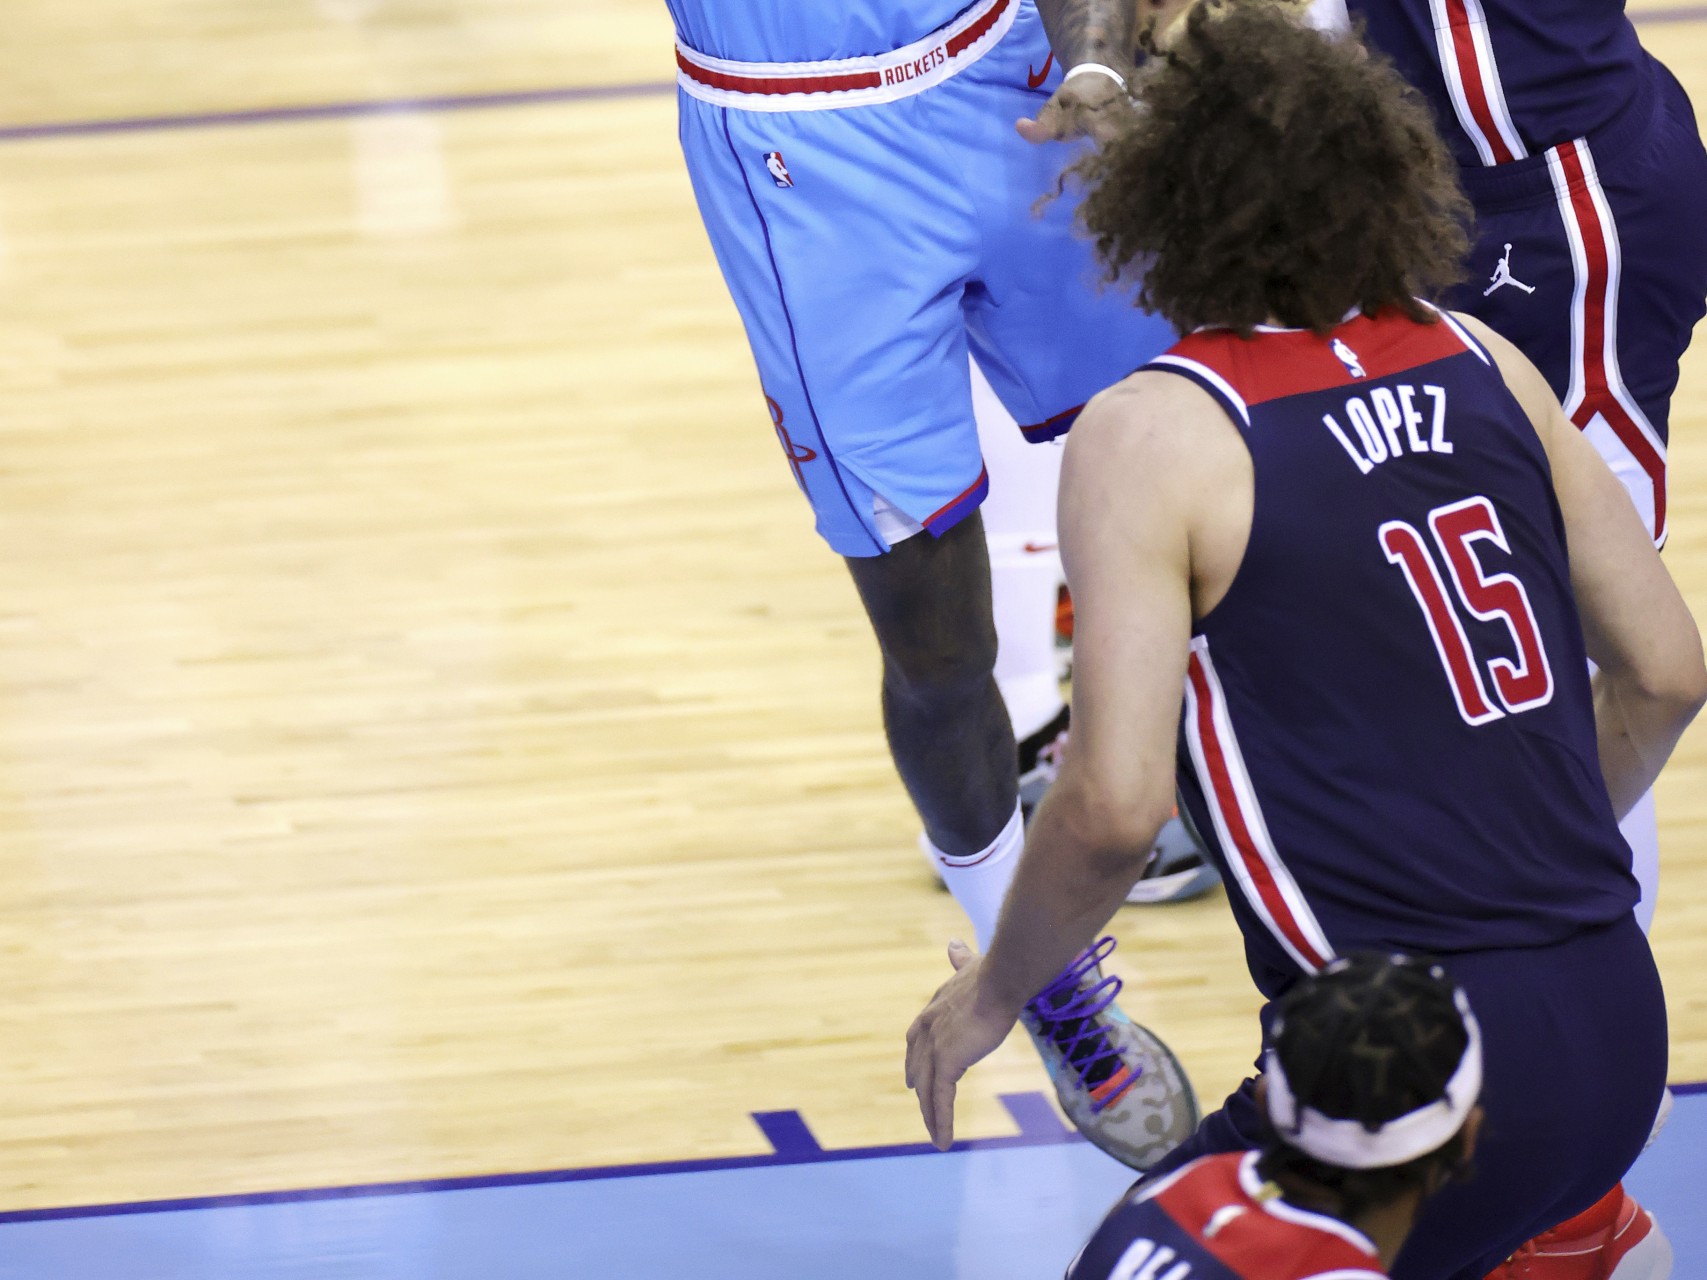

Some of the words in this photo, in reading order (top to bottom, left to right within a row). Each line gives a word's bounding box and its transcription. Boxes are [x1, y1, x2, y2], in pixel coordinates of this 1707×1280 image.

[885, 46, 945, 87] ROCKETS
[1322, 384, 1454, 475] LOPEZ
[1377, 495, 1555, 727] 15
